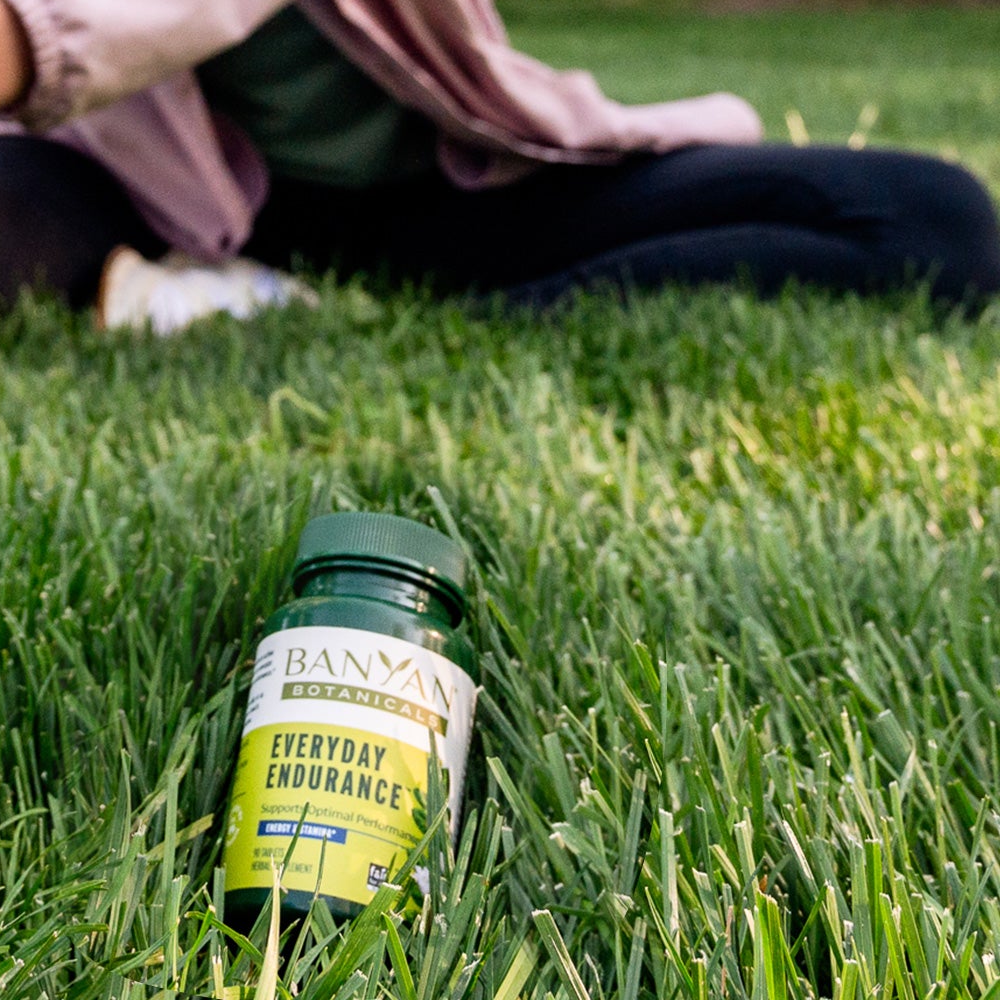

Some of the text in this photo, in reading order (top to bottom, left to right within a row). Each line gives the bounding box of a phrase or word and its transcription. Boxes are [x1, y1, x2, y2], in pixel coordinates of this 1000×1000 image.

[285, 648, 454, 712] BANYAN
[292, 684, 438, 727] BOTANICALS
[271, 733, 387, 771] EVERYDAY
[265, 764, 402, 811] ENDURANCE
[265, 823, 291, 834] ENERGY
[307, 804, 354, 822] Optimal
